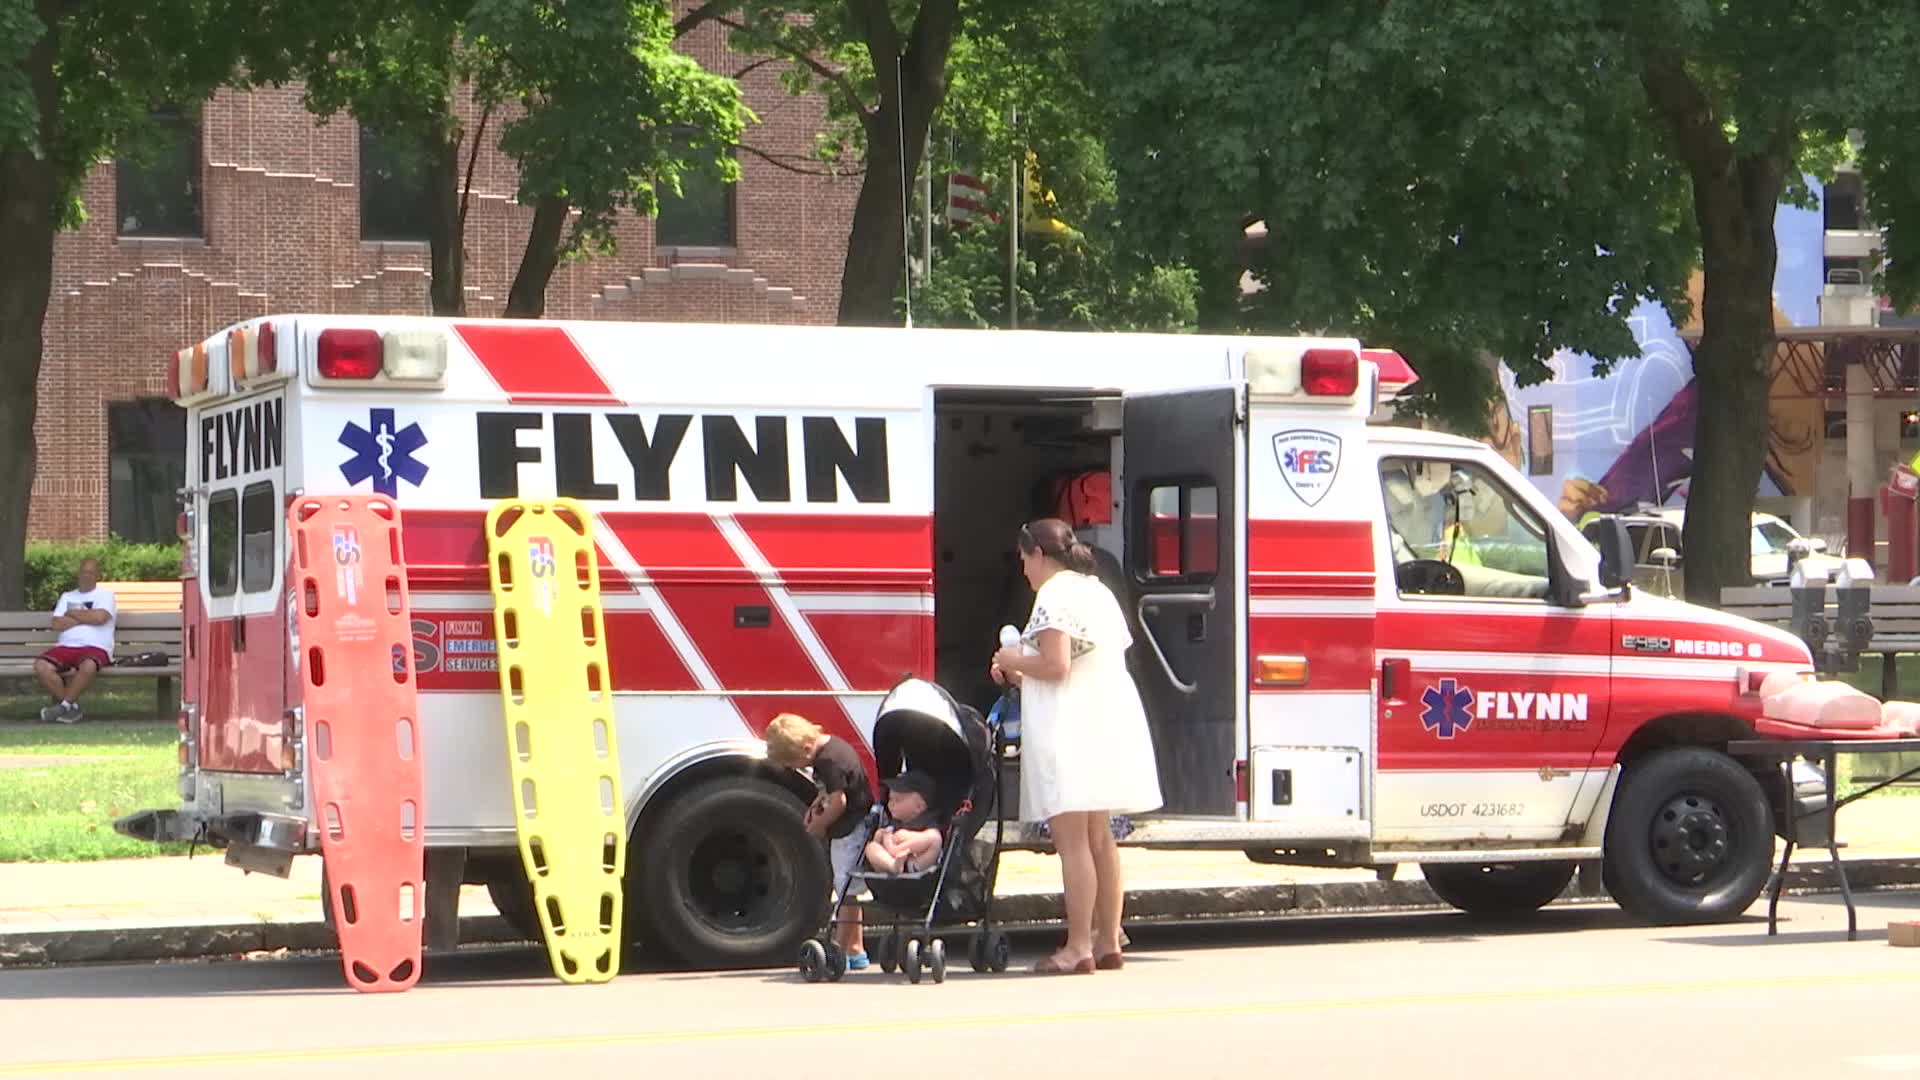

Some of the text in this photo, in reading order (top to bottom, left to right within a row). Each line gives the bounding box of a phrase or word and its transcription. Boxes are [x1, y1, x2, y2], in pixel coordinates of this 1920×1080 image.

[202, 396, 282, 483] FLYNN
[476, 411, 891, 503] FLYNN
[446, 640, 497, 652] EMERGE
[1674, 640, 1743, 656] MEDIC
[1476, 691, 1588, 720] FLYNN
[1421, 804, 1525, 817] USDOT 4231682
